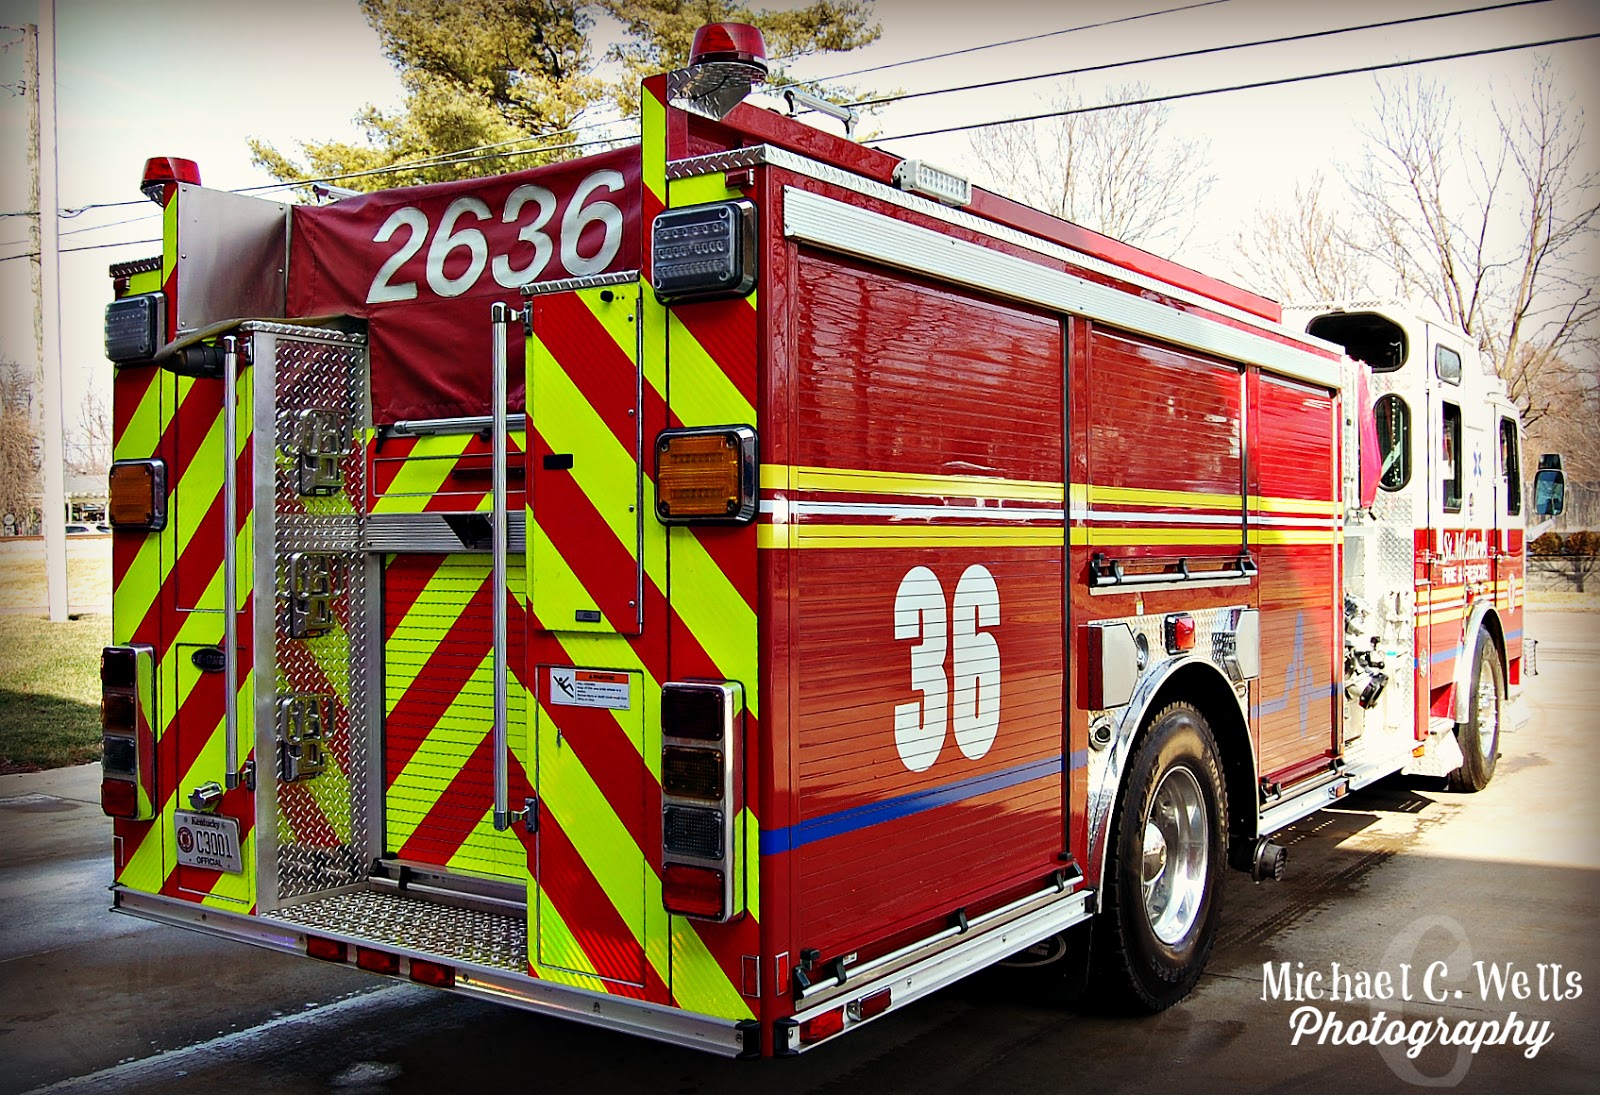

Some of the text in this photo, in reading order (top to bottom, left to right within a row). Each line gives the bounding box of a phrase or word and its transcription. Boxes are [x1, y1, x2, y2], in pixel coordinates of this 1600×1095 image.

[366, 169, 626, 304] 2636
[894, 563, 1001, 773] 36
[191, 816, 220, 830] Kentucky
[196, 830, 233, 859] C3001
[196, 856, 223, 867] OFFICIAL
